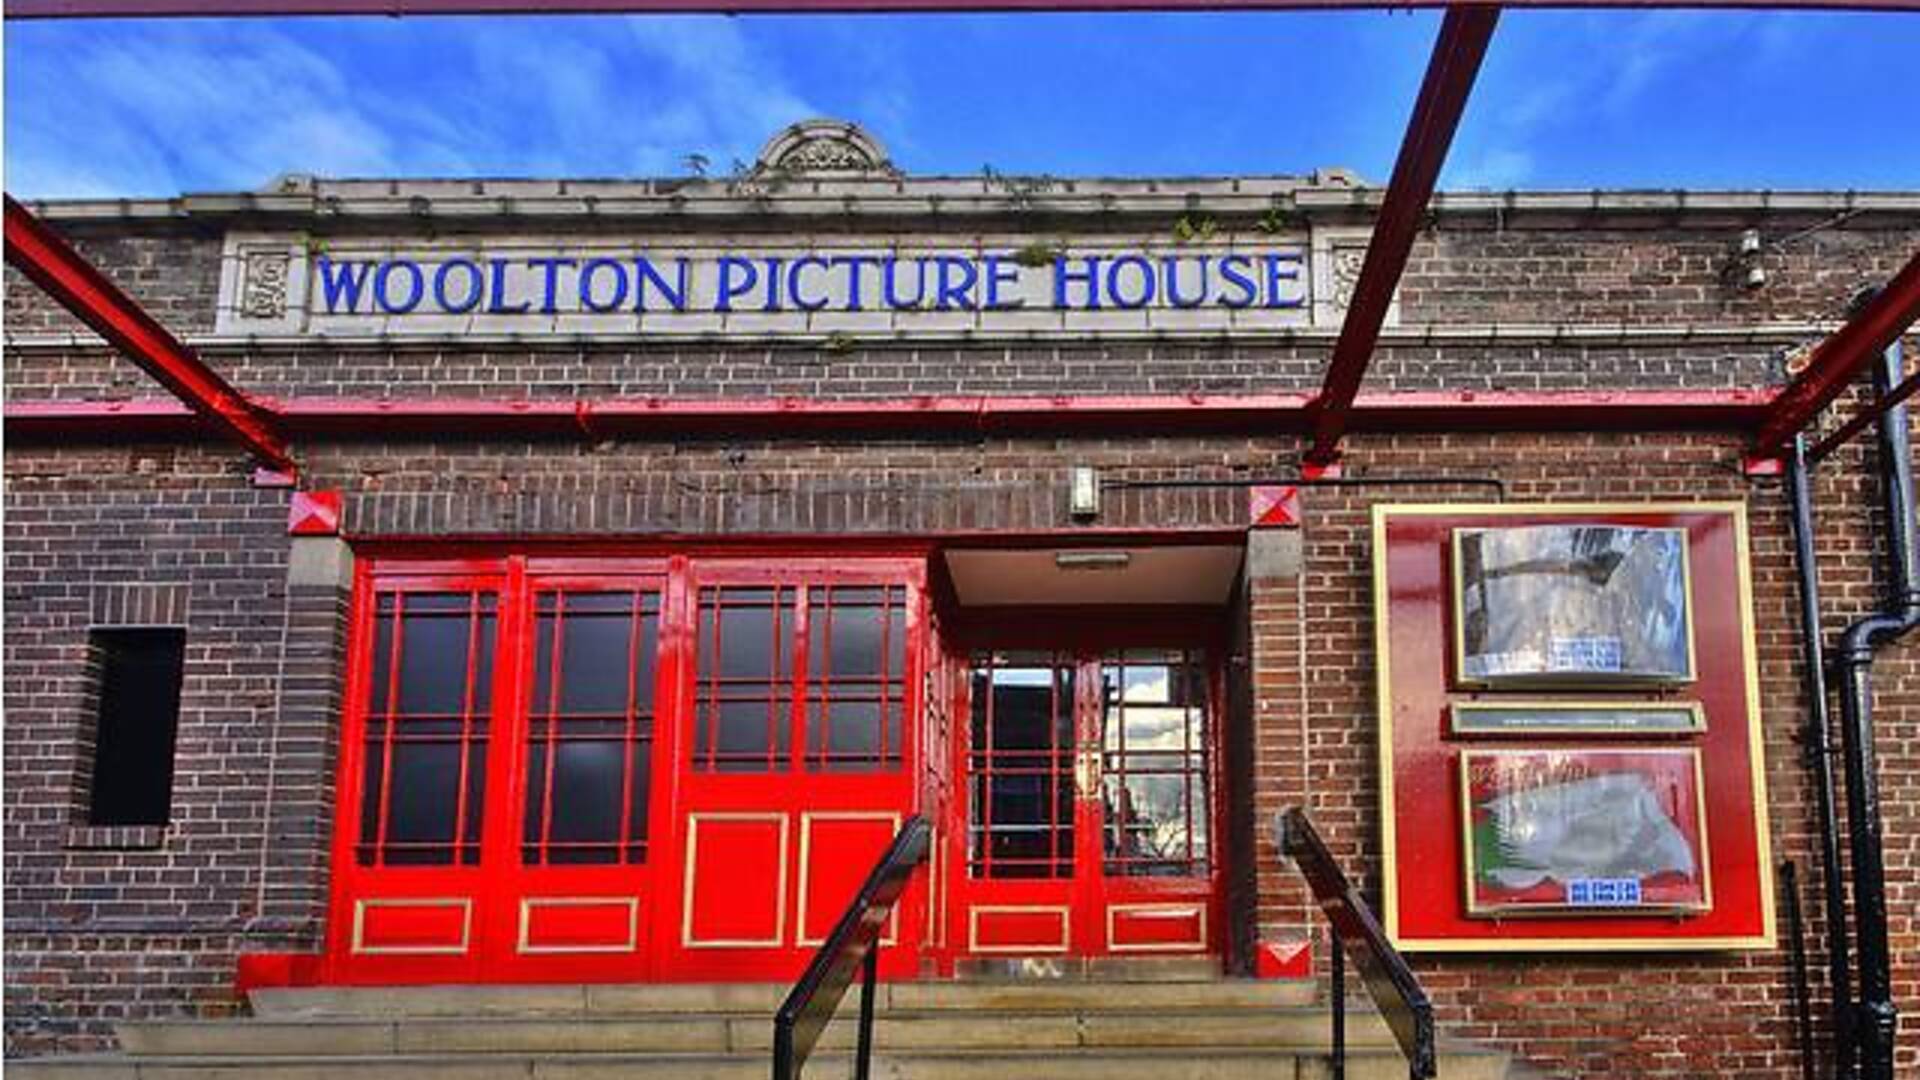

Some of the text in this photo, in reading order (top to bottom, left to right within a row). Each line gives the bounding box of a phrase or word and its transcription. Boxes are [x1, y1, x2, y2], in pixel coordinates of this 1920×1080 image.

[316, 254, 1305, 315] WOOLTON PICTURE HOUSE
